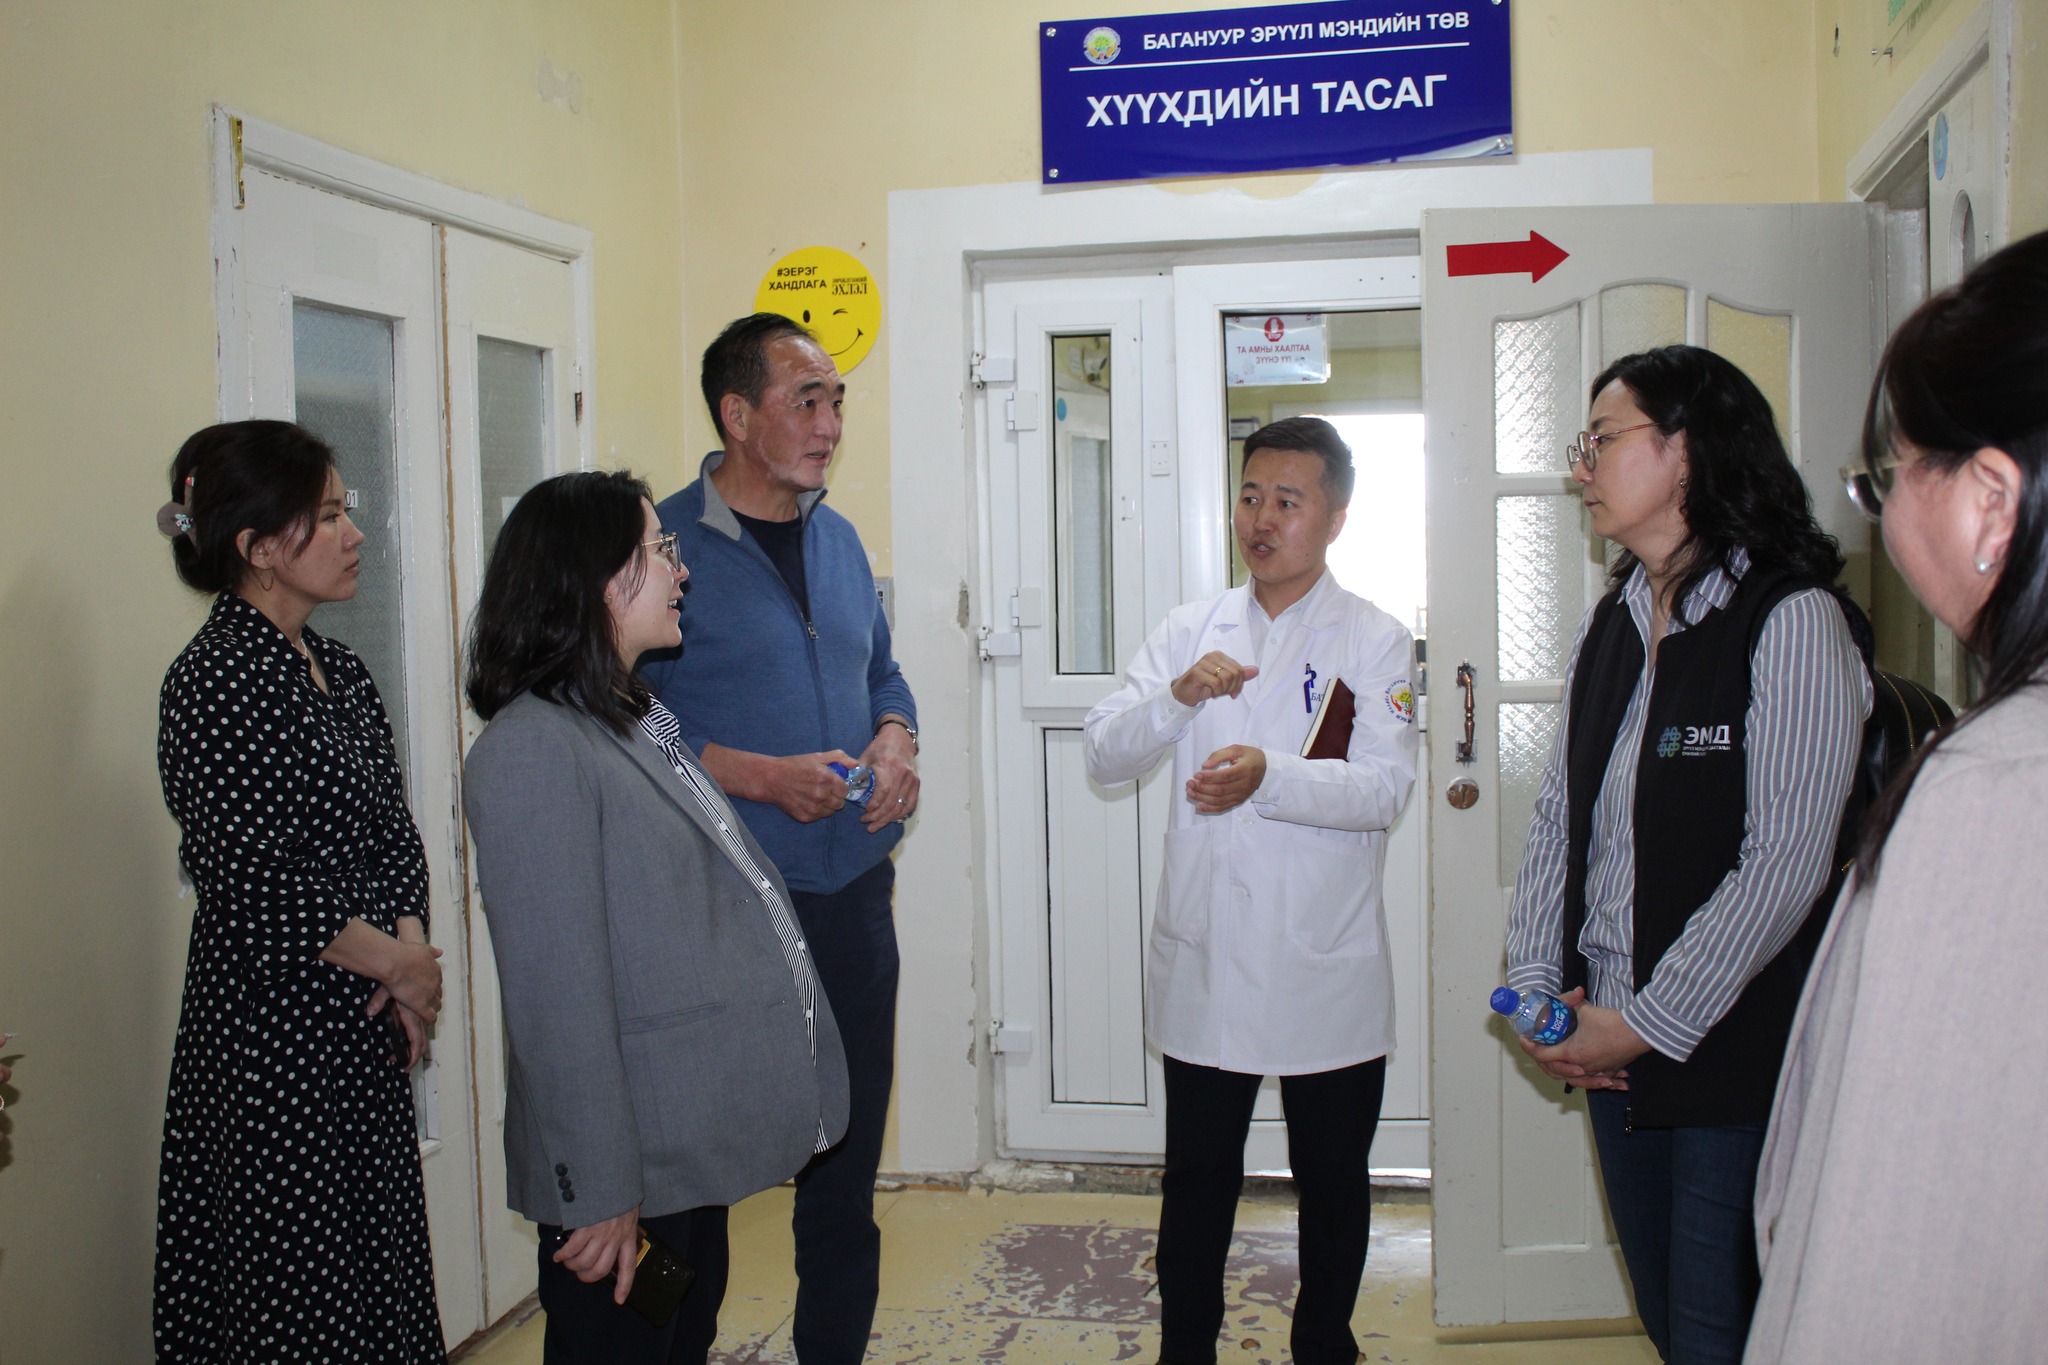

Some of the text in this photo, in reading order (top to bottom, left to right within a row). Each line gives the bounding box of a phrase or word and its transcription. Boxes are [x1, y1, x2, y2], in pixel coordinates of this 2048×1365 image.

[1144, 28, 1245, 50] БАГАНУУР
[1251, 23, 1313, 43] ЭРҮҮЛ
[1319, 12, 1421, 38] МЭНДИЙН
[1426, 11, 1470, 30] ТӨВ
[1086, 74, 1447, 128] ХҮҮХДИЙН ТАСАГ
[777, 266, 818, 277] #ЭЕРЭГ
[768, 279, 827, 291] ХАНДЛАГА
[1248, 345, 1273, 353] АМНЫ
[1274, 344, 1310, 352] ХААЛТАА
[1683, 725, 1731, 745] ЭМД
